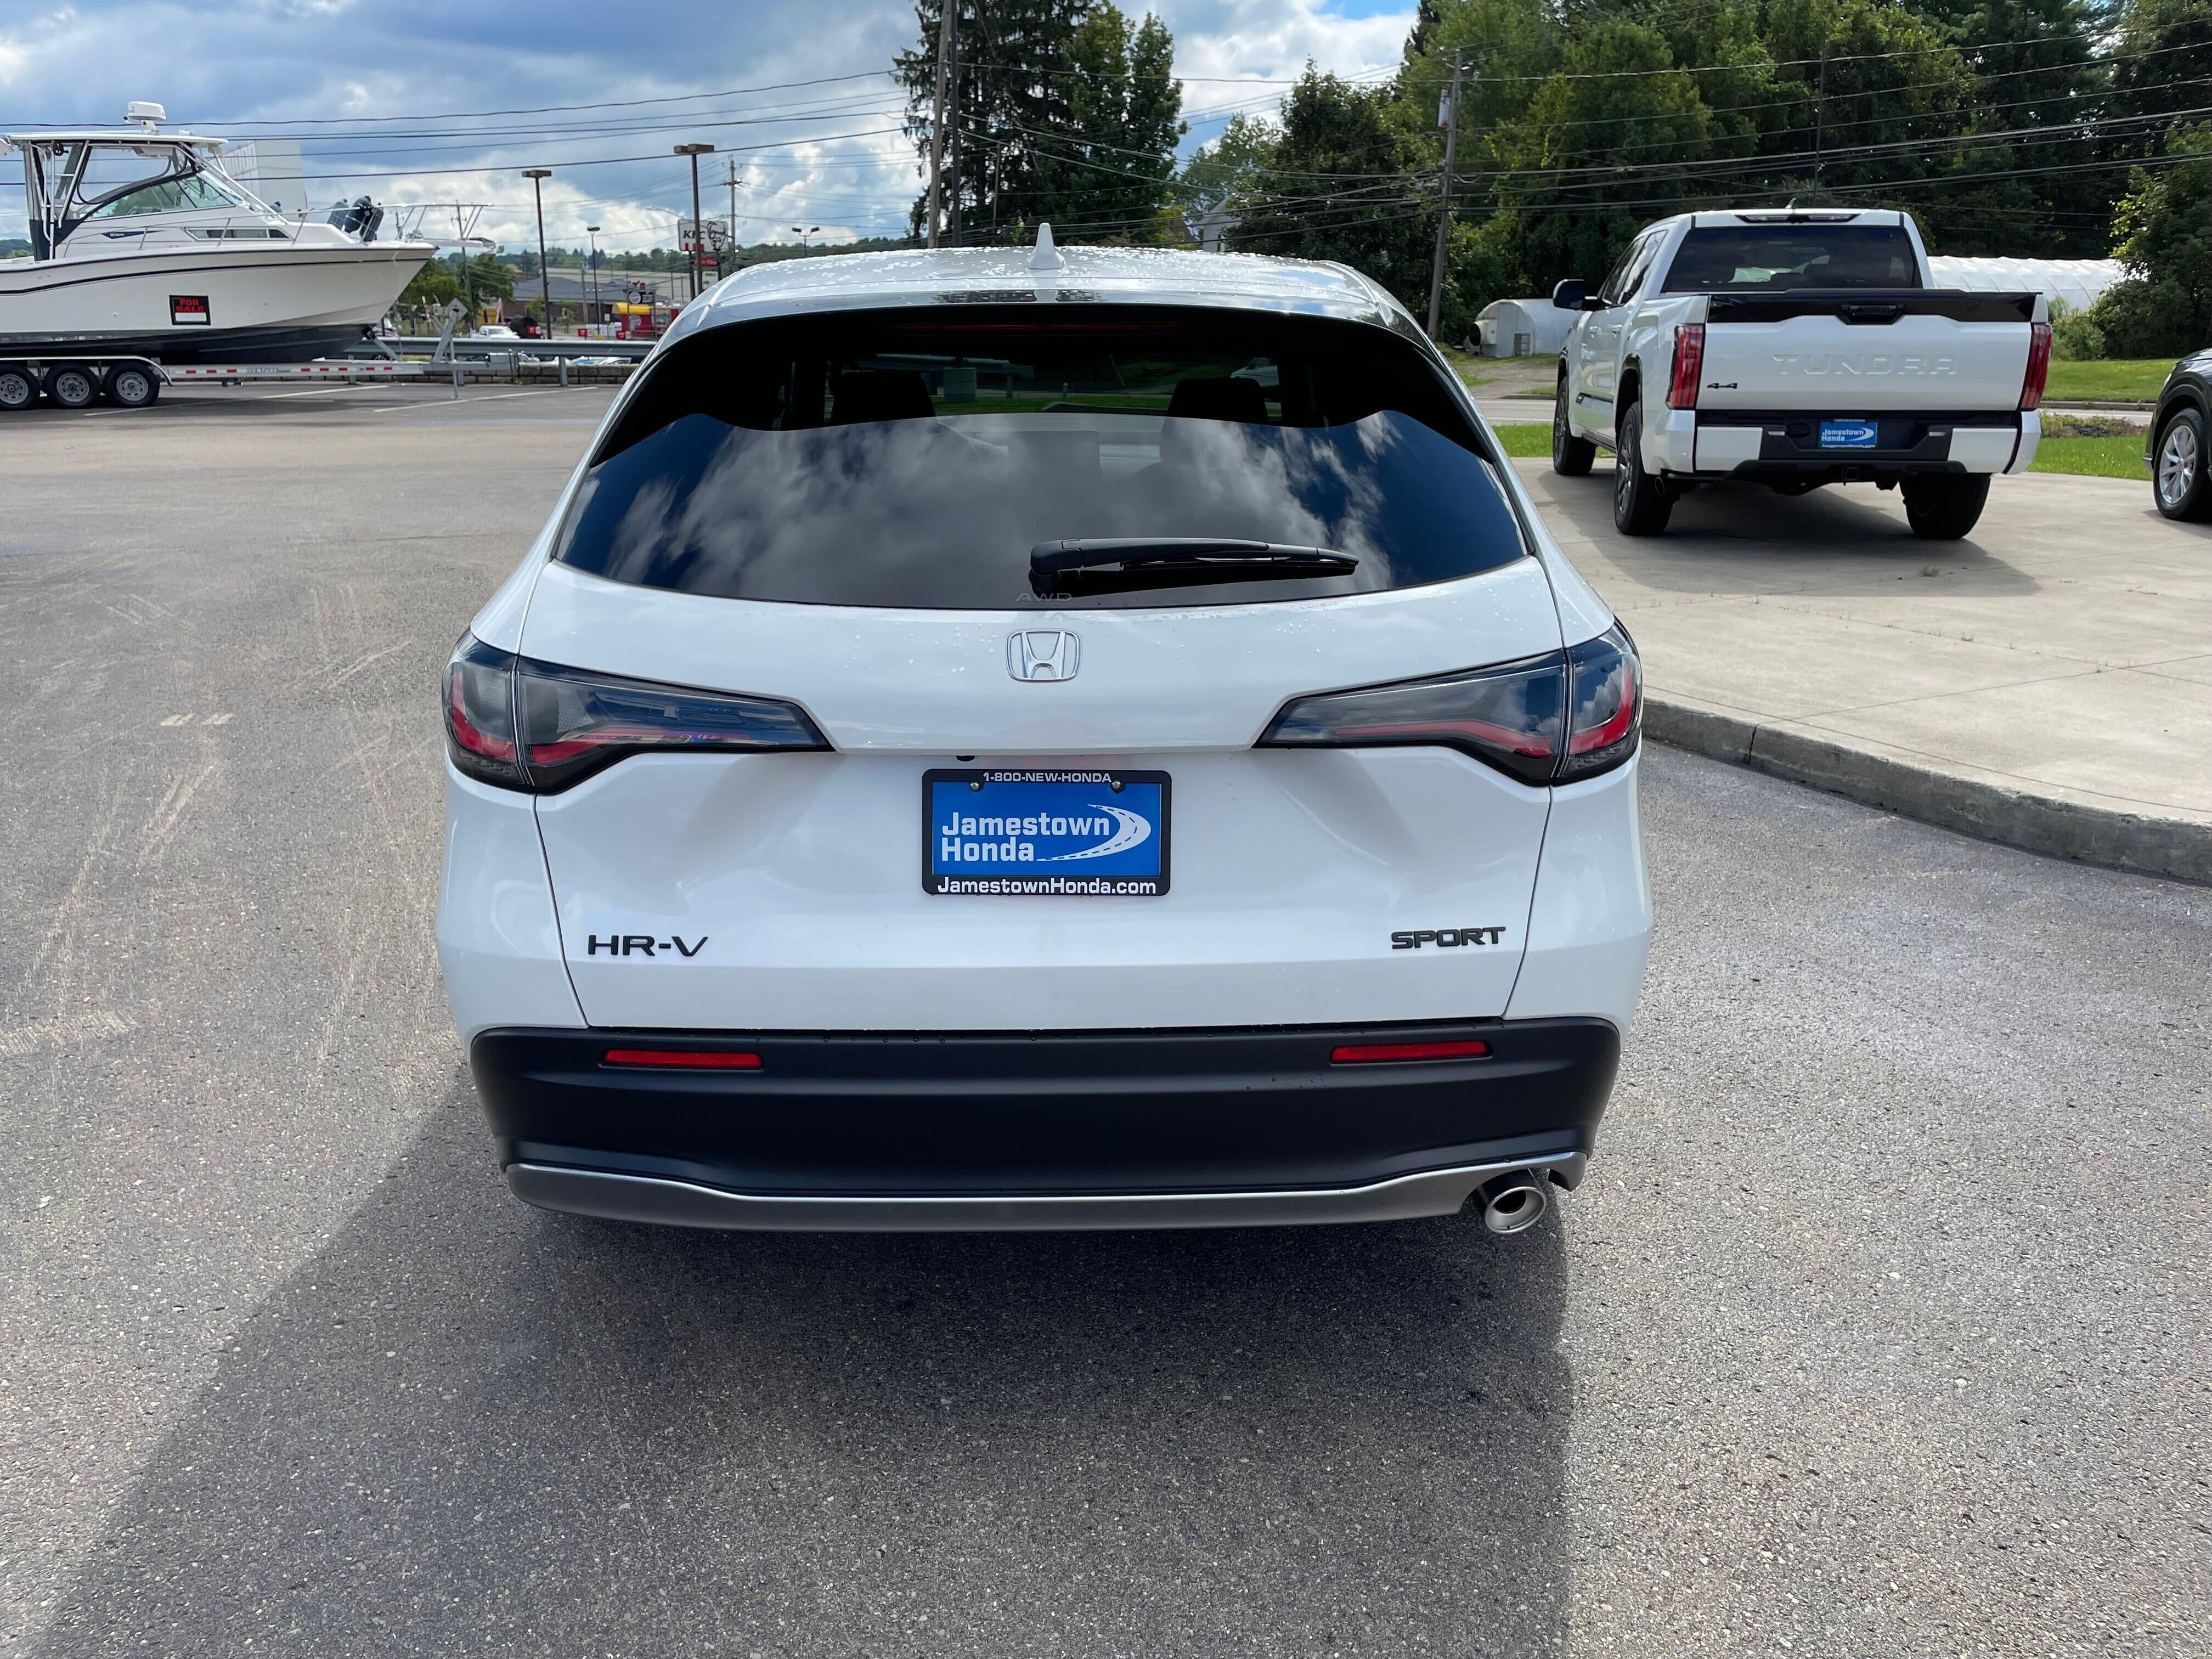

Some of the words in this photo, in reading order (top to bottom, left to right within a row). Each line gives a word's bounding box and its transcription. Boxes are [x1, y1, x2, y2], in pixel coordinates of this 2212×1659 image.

[1772, 354, 1956, 375] TUNDRA
[1015, 592, 1073, 602] AWD
[983, 771, 1112, 783] 1-800-NEW-HONDA
[941, 812, 1110, 836] Jamestown
[941, 836, 1034, 862] Honda
[937, 876, 1156, 894] JamestownHonda.com
[588, 934, 709, 957] HR-V
[1391, 926, 1506, 949] SPORT
